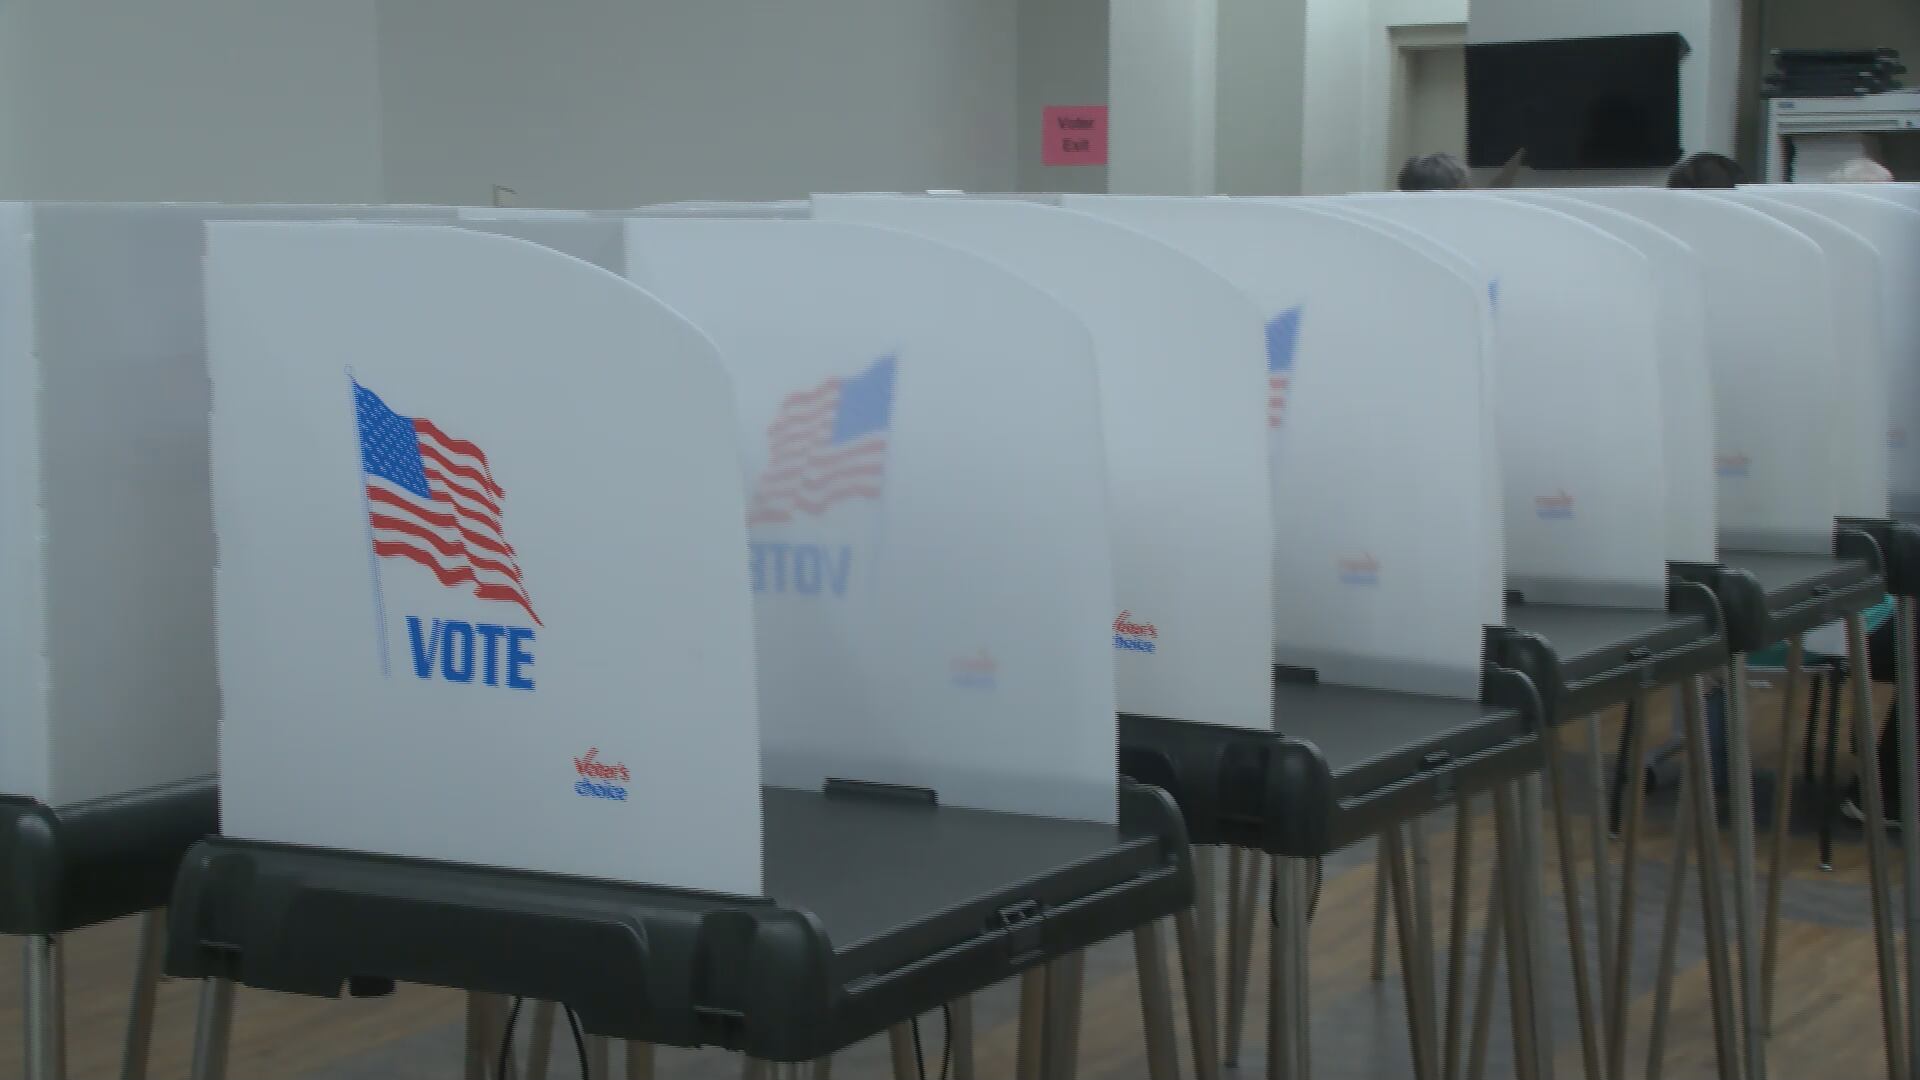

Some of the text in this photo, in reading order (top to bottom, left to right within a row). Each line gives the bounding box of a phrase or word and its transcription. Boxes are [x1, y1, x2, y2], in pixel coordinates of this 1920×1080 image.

[1057, 117, 1095, 130] Voter
[1062, 138, 1089, 152] Exit
[406, 615, 536, 691] VOTE
[574, 746, 630, 782] Voter's
[575, 777, 628, 802] choice
